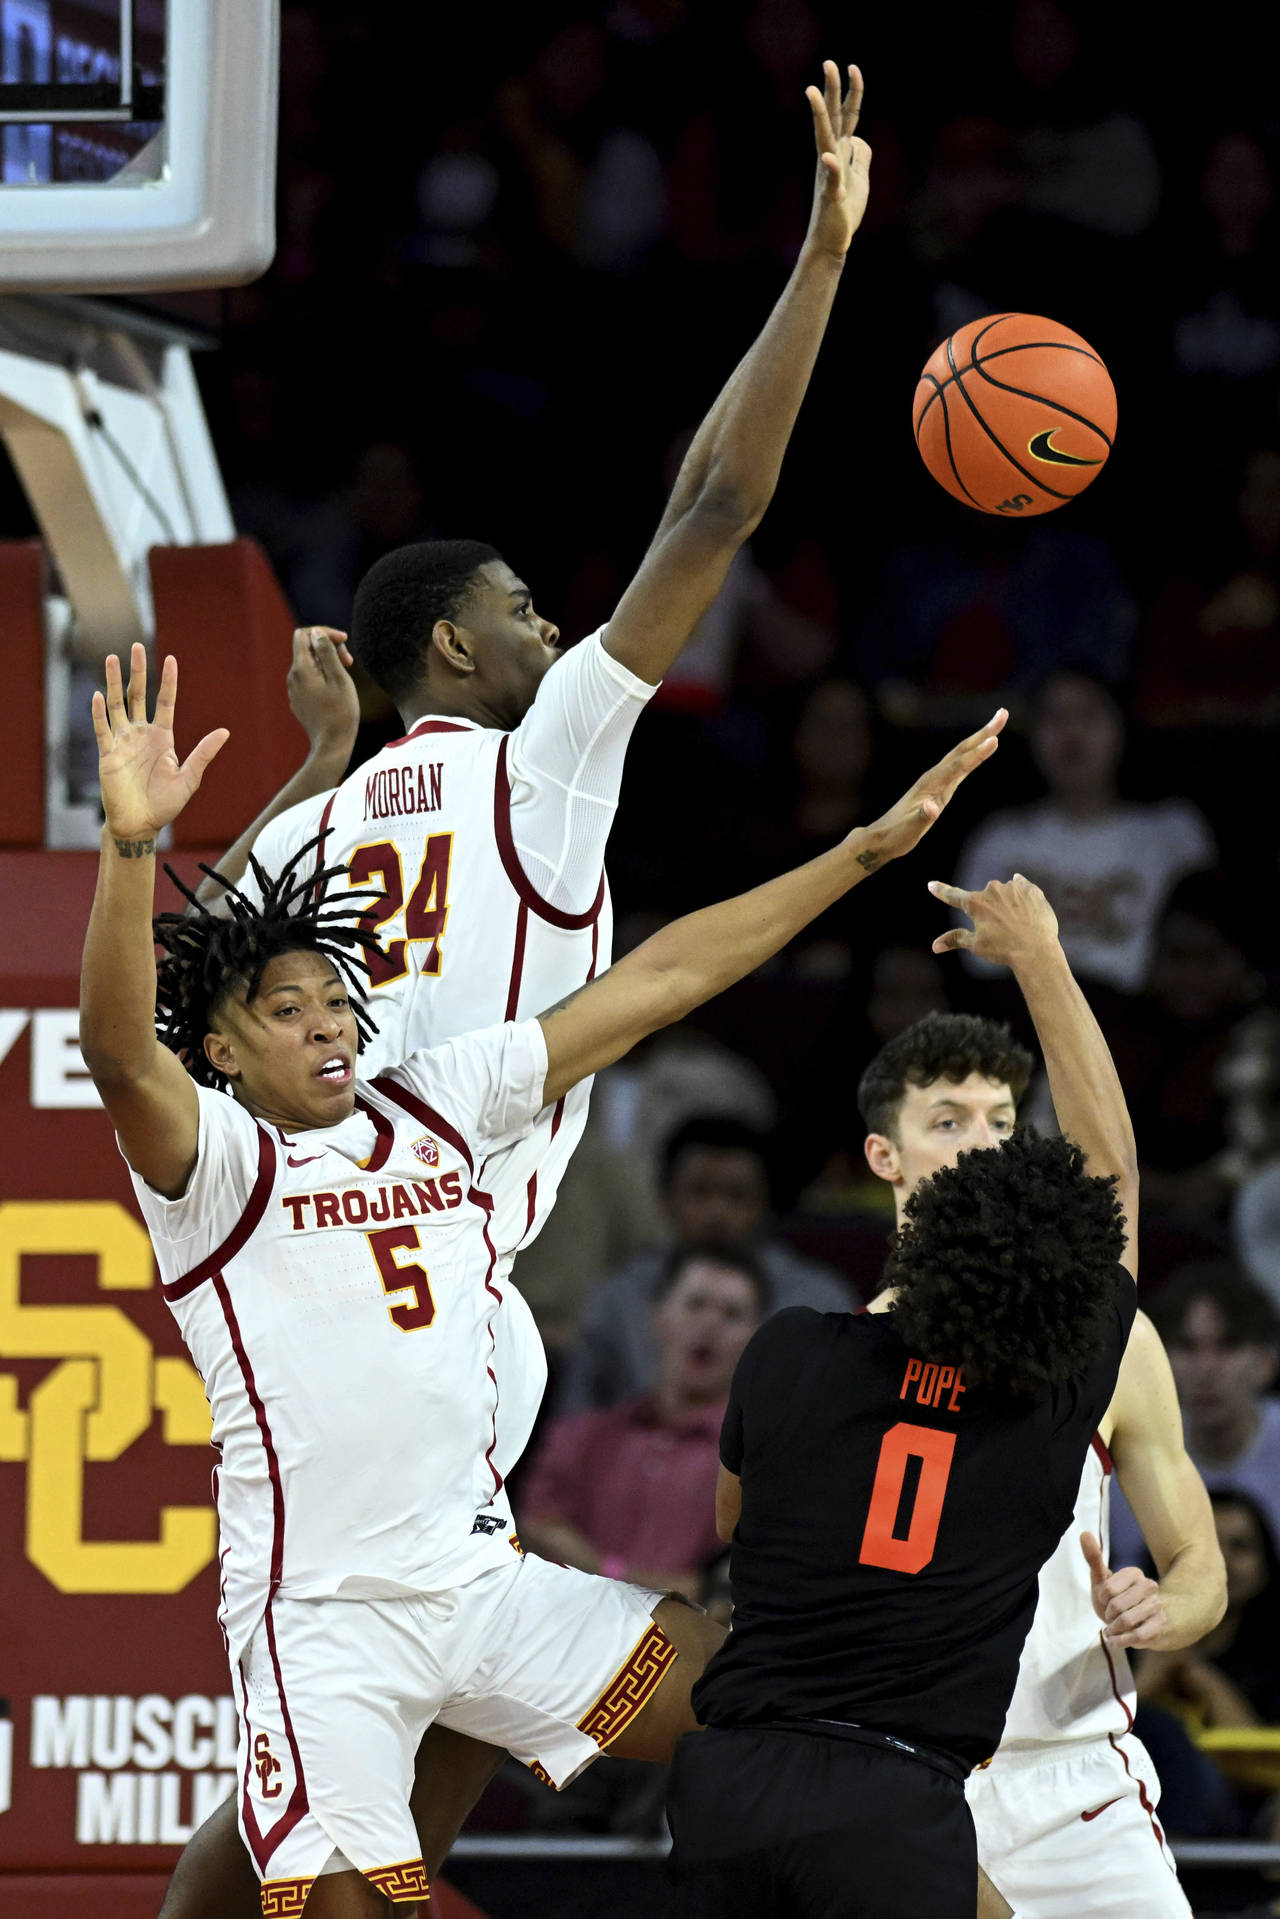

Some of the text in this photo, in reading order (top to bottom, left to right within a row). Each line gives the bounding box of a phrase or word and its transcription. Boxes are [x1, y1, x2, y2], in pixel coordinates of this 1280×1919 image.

[363, 762, 443, 821] MORGAN
[347, 831, 455, 989] 24
[282, 1171, 463, 1230] TROJANS
[365, 1224, 437, 1334] 5
[899, 1358, 966, 1412] POPE
[858, 1421, 957, 1575] 0
[31, 1694, 240, 1769] MUSCL
